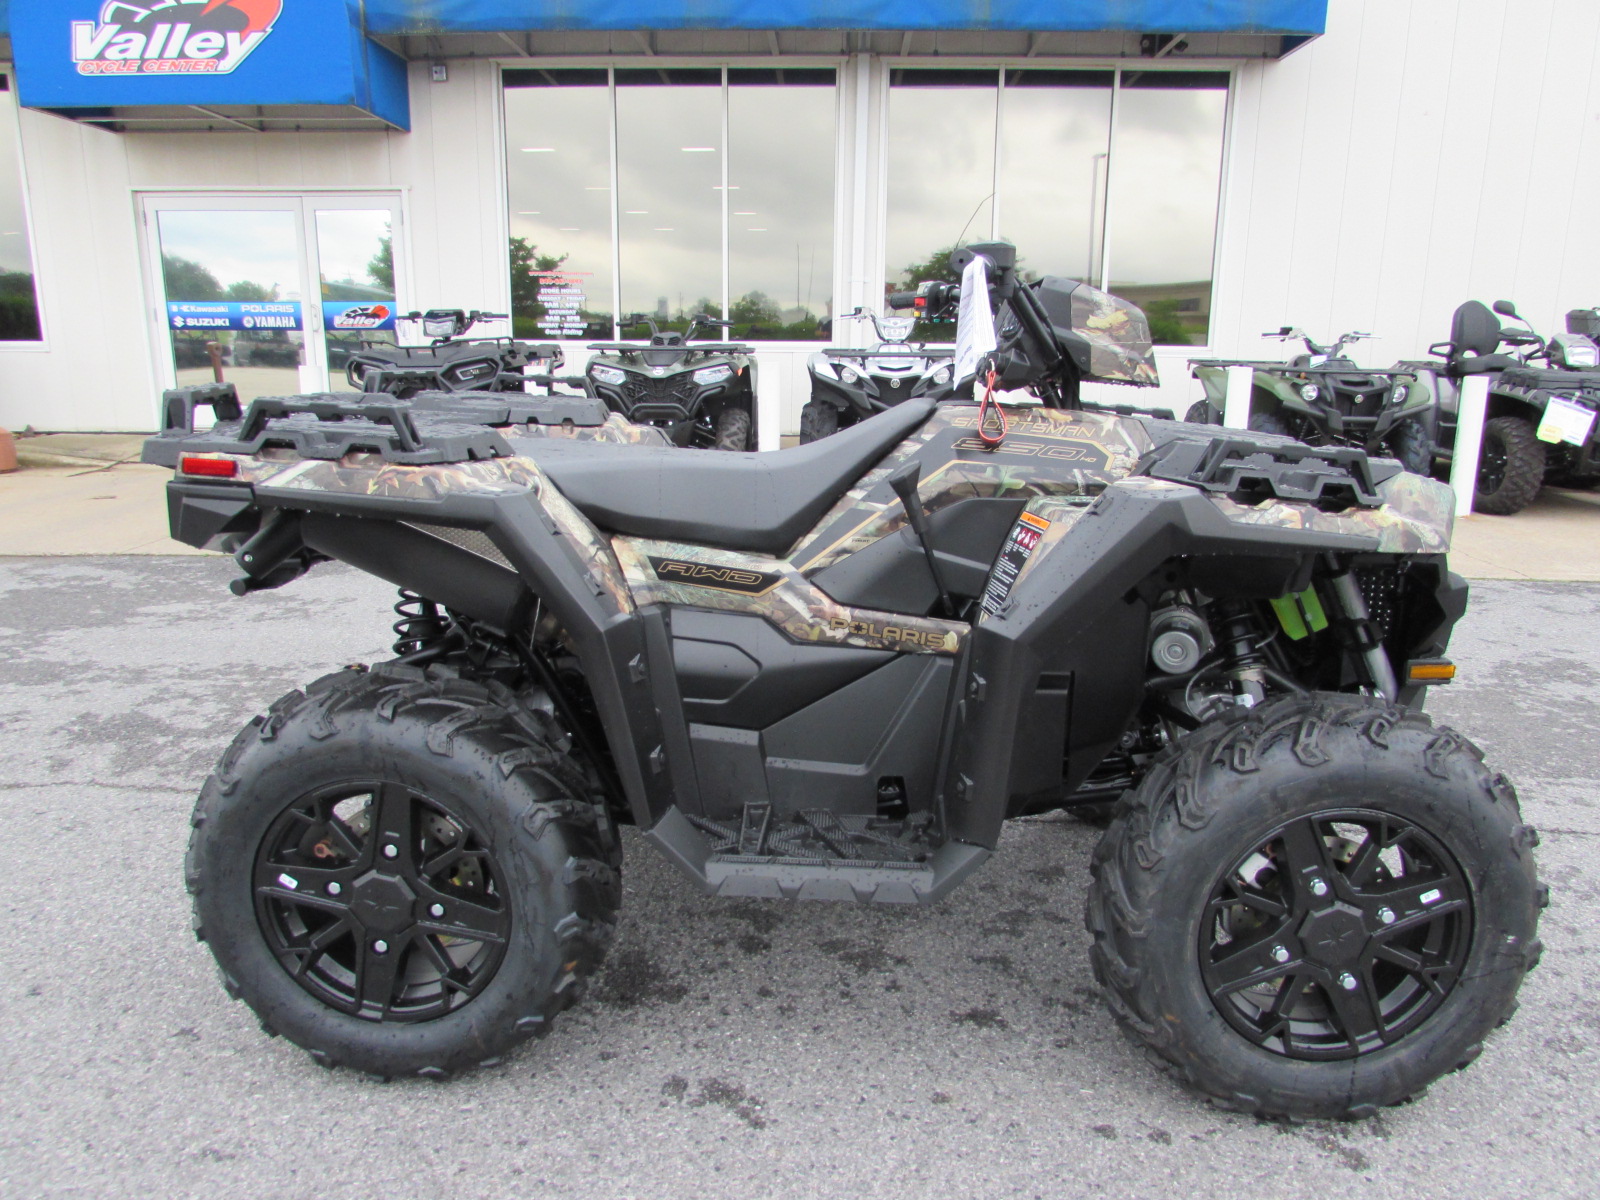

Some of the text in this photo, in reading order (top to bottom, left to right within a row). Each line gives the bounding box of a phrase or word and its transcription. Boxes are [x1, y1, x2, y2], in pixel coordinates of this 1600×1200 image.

[73, 22, 272, 71] Valley
[79, 59, 219, 73] CYCLE CENTER
[190, 304, 295, 313] Kawasaki POLARIS
[186, 316, 296, 328] SUZUKI YAMAHA
[334, 315, 388, 328] Valley
[657, 560, 763, 585] AWD
[829, 617, 946, 648] POLARIS
